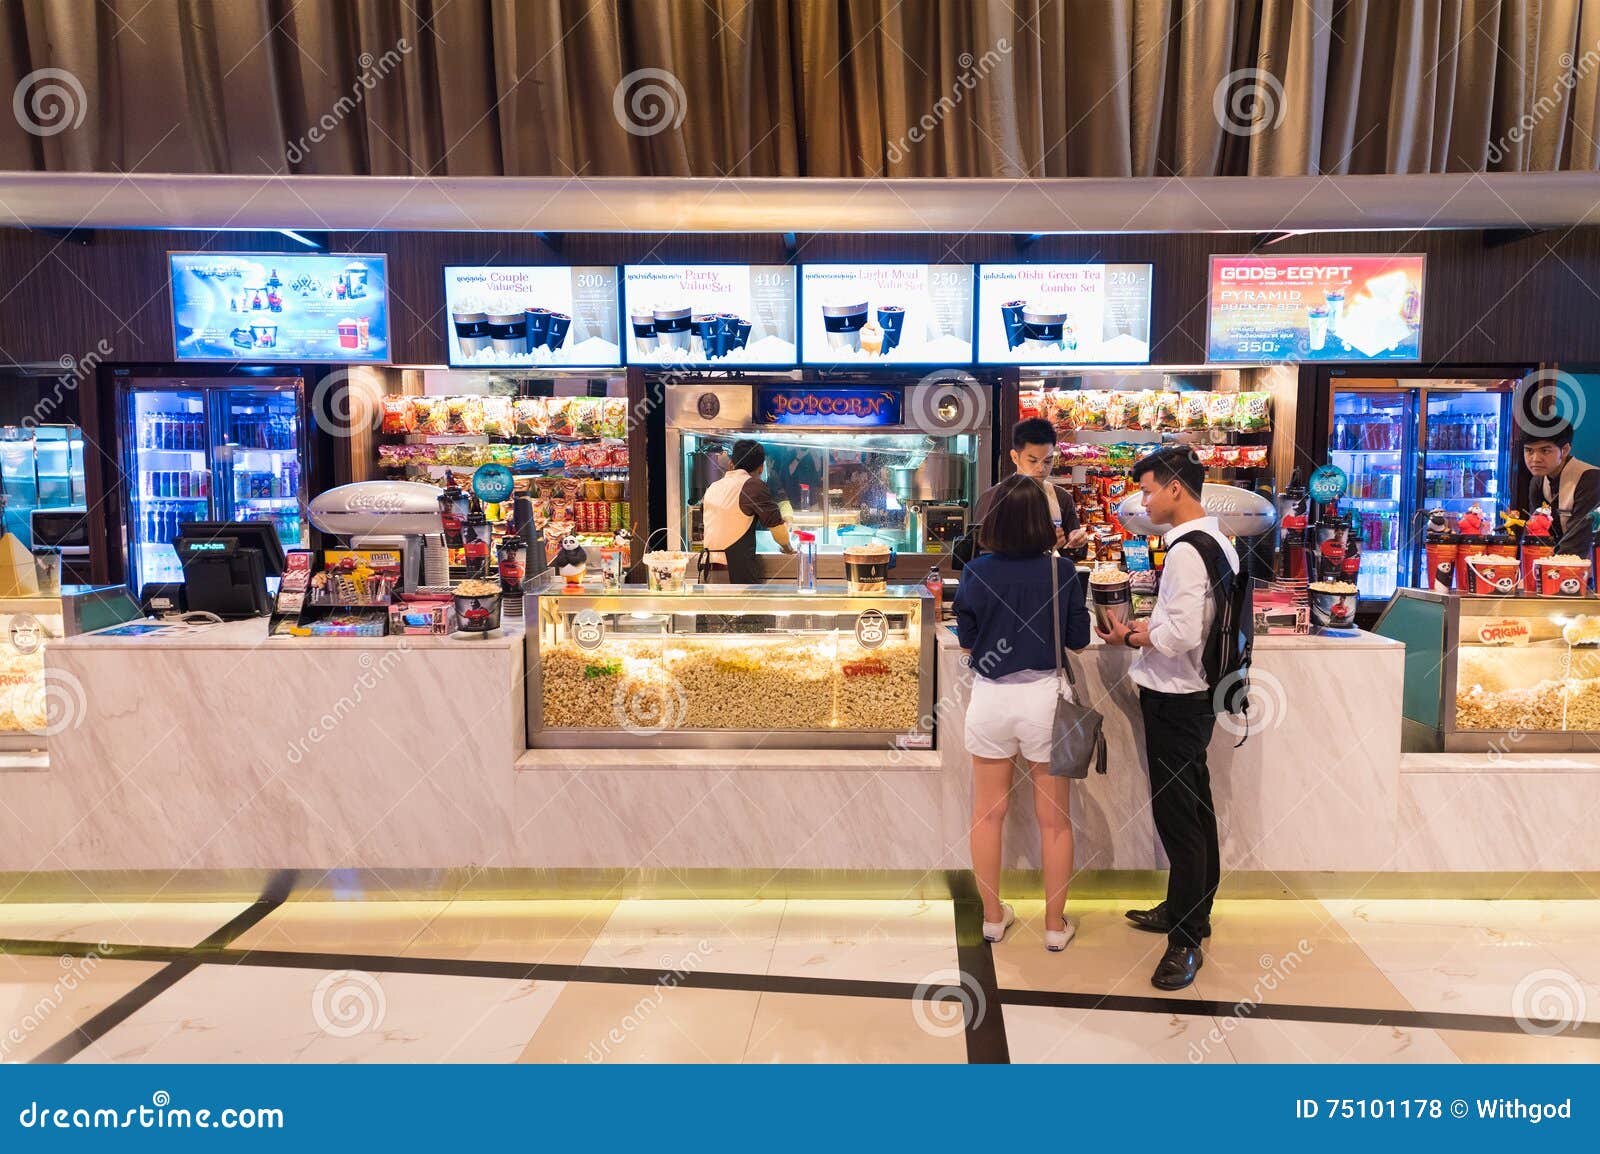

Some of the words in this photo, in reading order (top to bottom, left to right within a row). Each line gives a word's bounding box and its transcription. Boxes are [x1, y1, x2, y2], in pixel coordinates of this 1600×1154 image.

[490, 272, 529, 284] Couple
[685, 269, 719, 282] Party
[1048, 270, 1077, 280] Green
[1083, 270, 1101, 280] Tea
[1221, 267, 1277, 280] GODS
[1287, 267, 1353, 280] EGYPT
[1040, 283, 1076, 293] Combo
[1080, 283, 1096, 293] Set
[1221, 290, 1302, 301] PYRAMID
[773, 392, 885, 419] POPCORN
[1481, 625, 1529, 641] ORIGINAL
